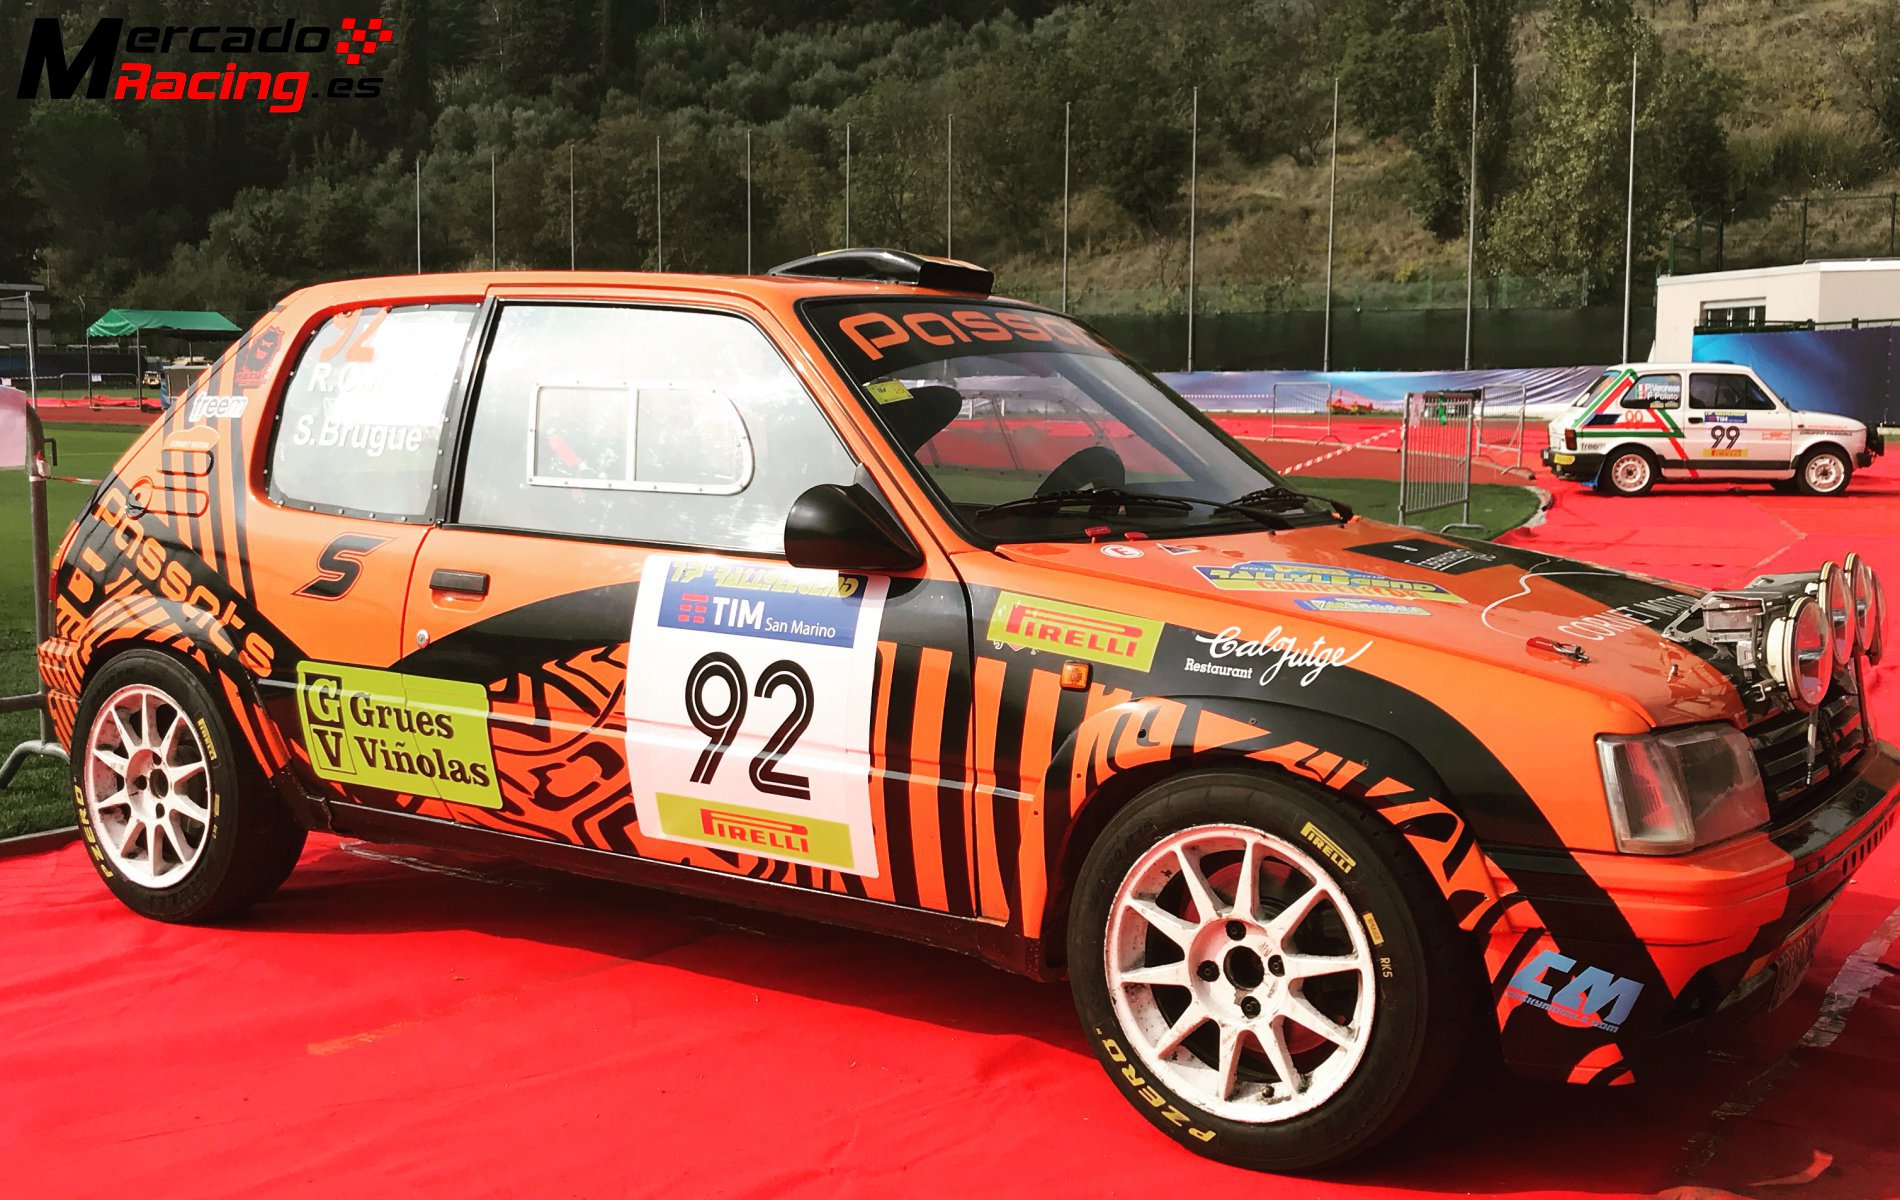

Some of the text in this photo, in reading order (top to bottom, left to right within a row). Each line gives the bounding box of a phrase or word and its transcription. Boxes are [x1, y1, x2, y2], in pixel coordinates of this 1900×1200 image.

[1711, 425, 1740, 449] 99
[713, 597, 836, 639] TIM San Marino
[1006, 604, 1144, 658] PIRELLI
[1184, 657, 1254, 680] Restaurant
[350, 692, 455, 740] Grues
[685, 651, 815, 800] 92
[354, 735, 491, 788] Viñolas
[700, 808, 809, 853] PIRELLI
[1300, 821, 1357, 874] PIRELLI
[1380, 957, 1394, 978] RK5
